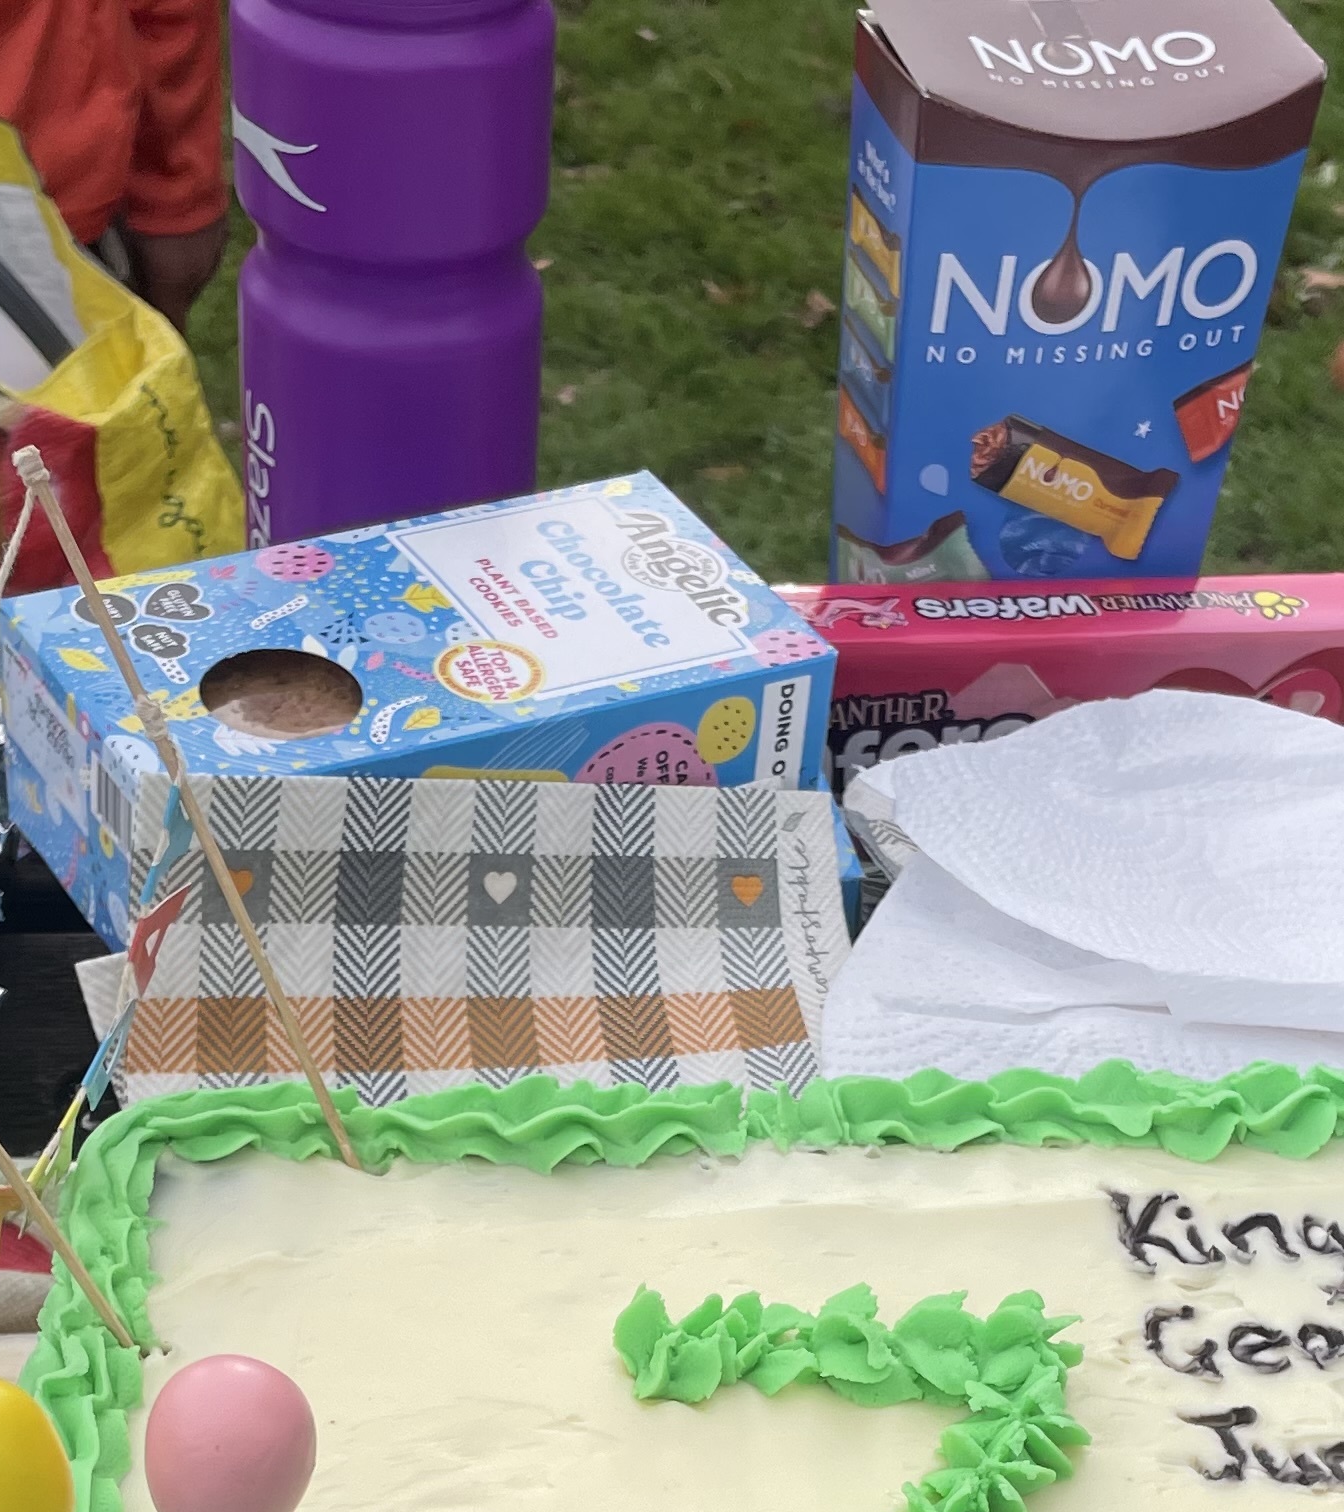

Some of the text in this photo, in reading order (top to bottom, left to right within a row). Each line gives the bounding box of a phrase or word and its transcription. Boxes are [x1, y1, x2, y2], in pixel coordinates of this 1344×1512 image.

[968, 30, 1217, 76] NOMO
[988, 64, 1226, 89] NO MISSING OUT
[929, 239, 1259, 336] NOMO
[925, 325, 1248, 366] NO MISSING OUT
[1217, 384, 1246, 419] N
[1020, 456, 1094, 502] NOMO
[519, 559, 588, 622] Chip
[536, 520, 671, 649] Chocolate
[616, 512, 742, 628] Angelic
[468, 577, 524, 628] COOKIES
[475, 558, 521, 596] PLANT
[516, 598, 559, 639] BASED
[914, 594, 1096, 620] wafers
[155, 631, 179, 648] NUT
[455, 660, 483, 687] SAFE
[466, 645, 509, 700] ALLERGEN
[488, 650, 512, 673] TOP
[501, 676, 521, 689] 14
[774, 683, 796, 753] DOING
[786, 839, 830, 995] compostable
